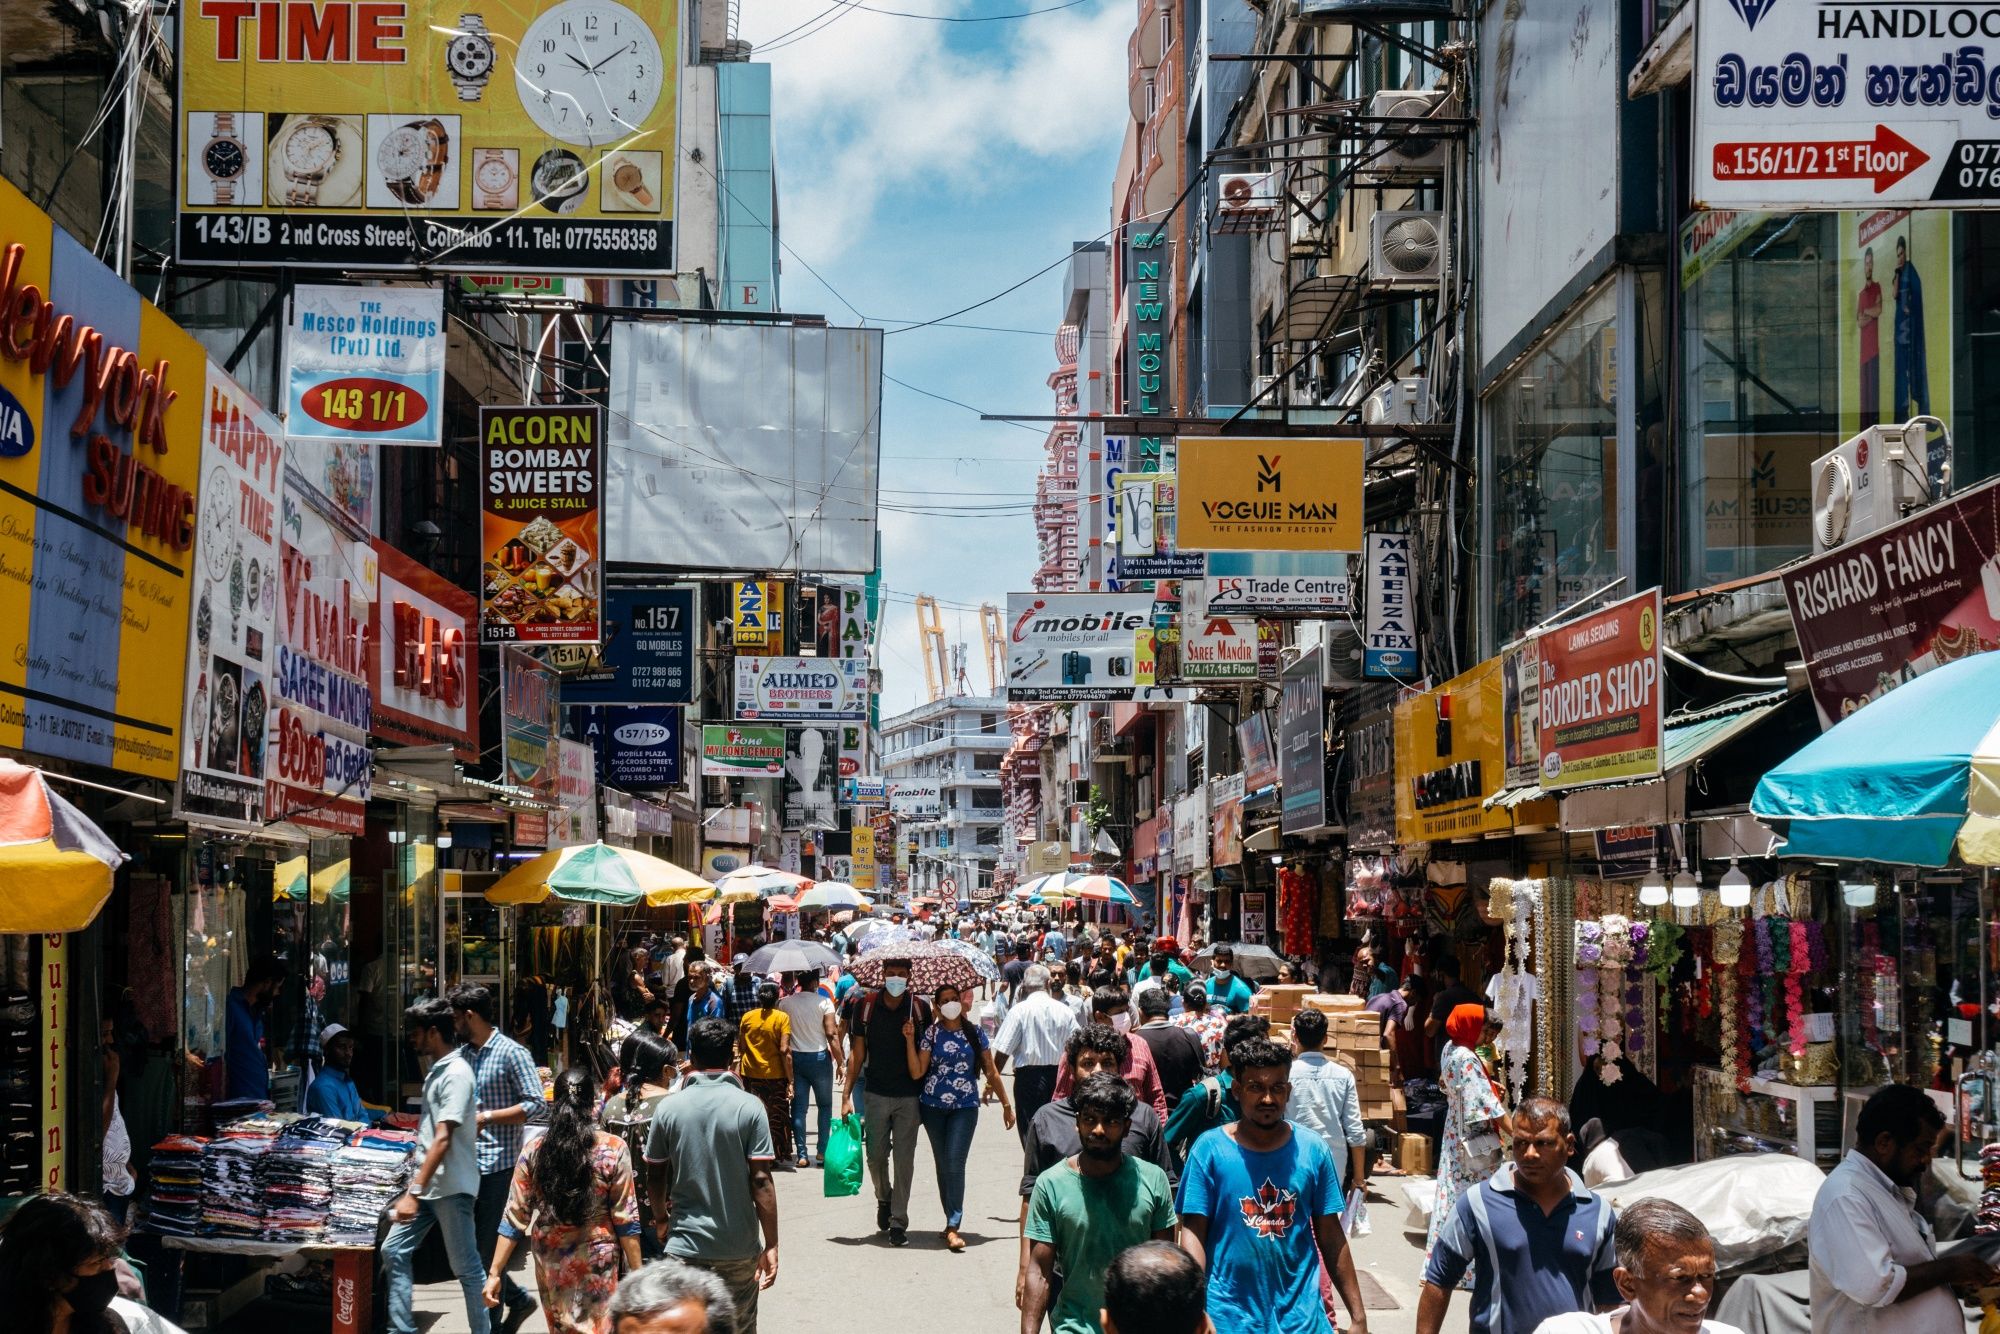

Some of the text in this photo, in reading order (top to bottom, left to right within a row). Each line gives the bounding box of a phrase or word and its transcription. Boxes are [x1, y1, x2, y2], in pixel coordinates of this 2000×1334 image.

[201, 1, 407, 64] TIME
[1716, 144, 1909, 175] No. 156/1/2 1st Floor
[195, 215, 271, 244] 143/B
[317, 224, 360, 246] Cross
[365, 224, 416, 251] Street,
[506, 226, 529, 248] 11.
[533, 227, 561, 250] Tel:
[565, 227, 658, 251] 0775558358
[1135, 261, 1163, 322] NEW
[360, 301, 382, 314] THE
[303, 312, 436, 339] Mesco Holdings
[331, 336, 405, 359] (Pvt) Ltd.
[321, 388, 406, 422] 143 1/1
[487, 415, 592, 445] ACORN
[210, 385, 282, 496] HAPPY
[490, 448, 592, 469] BOMBAY
[489, 471, 592, 494] SWEETS
[1857, 474, 1870, 490] LG
[494, 498, 588, 509] & JUICE STALL
[1202, 501, 1337, 520] VOGUE MAN
[240, 479, 274, 549] TIME
[1213, 525, 1334, 534] THE FASHION FACTORY
[1123, 558, 1196, 568] 174 1/1, Thaika Plaza, 2nd
[1123, 568, 1191, 576] Tel: 011 2441936 Email:
[1793, 519, 1956, 621] RISHARD FANCY
[1246, 578, 1347, 594] Trade Centre
[1370, 537, 1413, 649] MAHEEZA TEX
[1920, 582, 1943, 598] Rishard
[635, 607, 680, 630] NO. 157
[1032, 611, 1144, 633] mobile
[68, 630, 86, 643] and
[487, 626, 516, 638] 151-B
[1047, 632, 1109, 646] mobiles for all
[1568, 619, 1619, 651] LANKA SEQUINS
[1813, 621, 1917, 661] WHOLESALERS AND RETAILERS IN ALL KINDS OF
[649, 640, 683, 651] MOBILES
[552, 647, 587, 665] 151/A
[1836, 662, 1851, 674] GENTS
[1850, 652, 1884, 669] ACCESSORIES
[632, 666, 651, 676] 0727
[1184, 665, 1200, 674] 174
[1232, 664, 1255, 674] Floor
[1542, 660, 1556, 683] The
[280, 644, 326, 715] SAREE
[632, 678, 682, 688] 0112 447 489
[761, 673, 838, 689] AHMED
[769, 688, 833, 700] BROTHERS
[1542, 656, 1656, 730] BORDER SHOP
[620, 728, 665, 740] 157/159
[732, 733, 763, 746] Fone
[705, 745, 783, 758] MY FONE CENTER
[652, 758, 673, 766] STREET,
[894, 787, 936, 798] mobile
[1255, 1215, 1286, 1228] Canada
